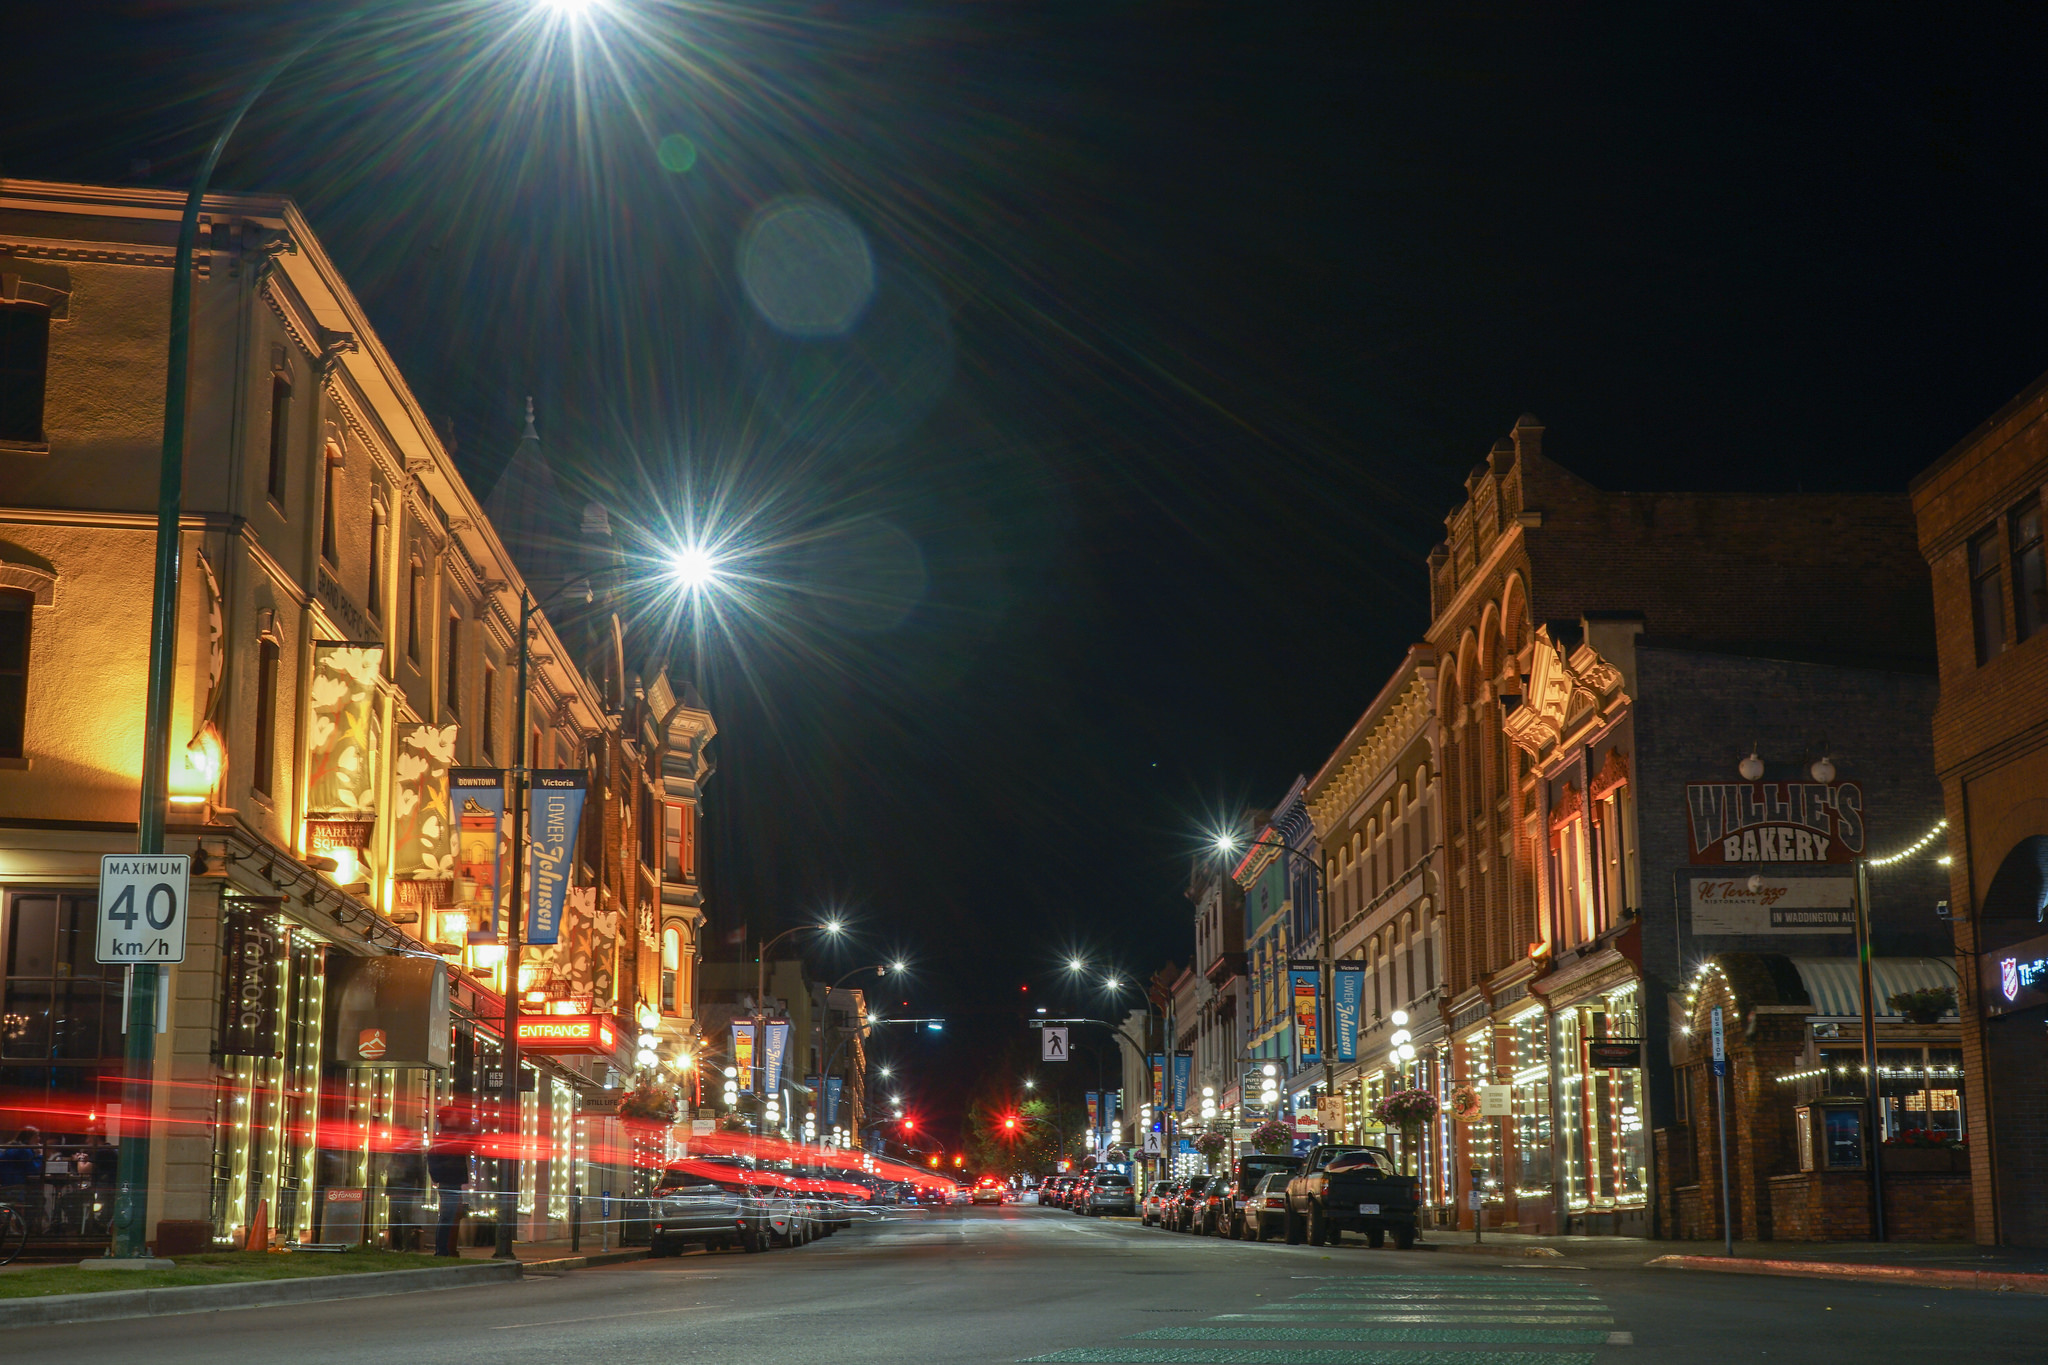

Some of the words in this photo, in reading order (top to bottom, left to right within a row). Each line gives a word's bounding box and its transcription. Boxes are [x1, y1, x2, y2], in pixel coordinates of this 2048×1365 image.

[457, 778, 496, 786] DOWNTOWN
[542, 779, 574, 787] Victoria
[547, 796, 565, 843] LOWER
[1687, 783, 1864, 855] WILLIE'S
[313, 826, 364, 838] MARKET
[1723, 826, 1830, 862] BAKERY
[109, 862, 181, 875] MAXIMUM
[533, 841, 564, 931] Johnson
[1718, 881, 1788, 906] Terrzzo
[108, 882, 177, 930] 40
[1773, 912, 1782, 923] IN
[1785, 912, 1839, 923] WADDINGTON
[1841, 912, 1857, 923] ALL
[112, 938, 169, 956] km/h
[1344, 975, 1354, 1004] LOWER
[519, 1024, 590, 1037] ENTRANCE
[1336, 1002, 1355, 1055] Johnson
[489, 1080, 503, 1088] HAP
